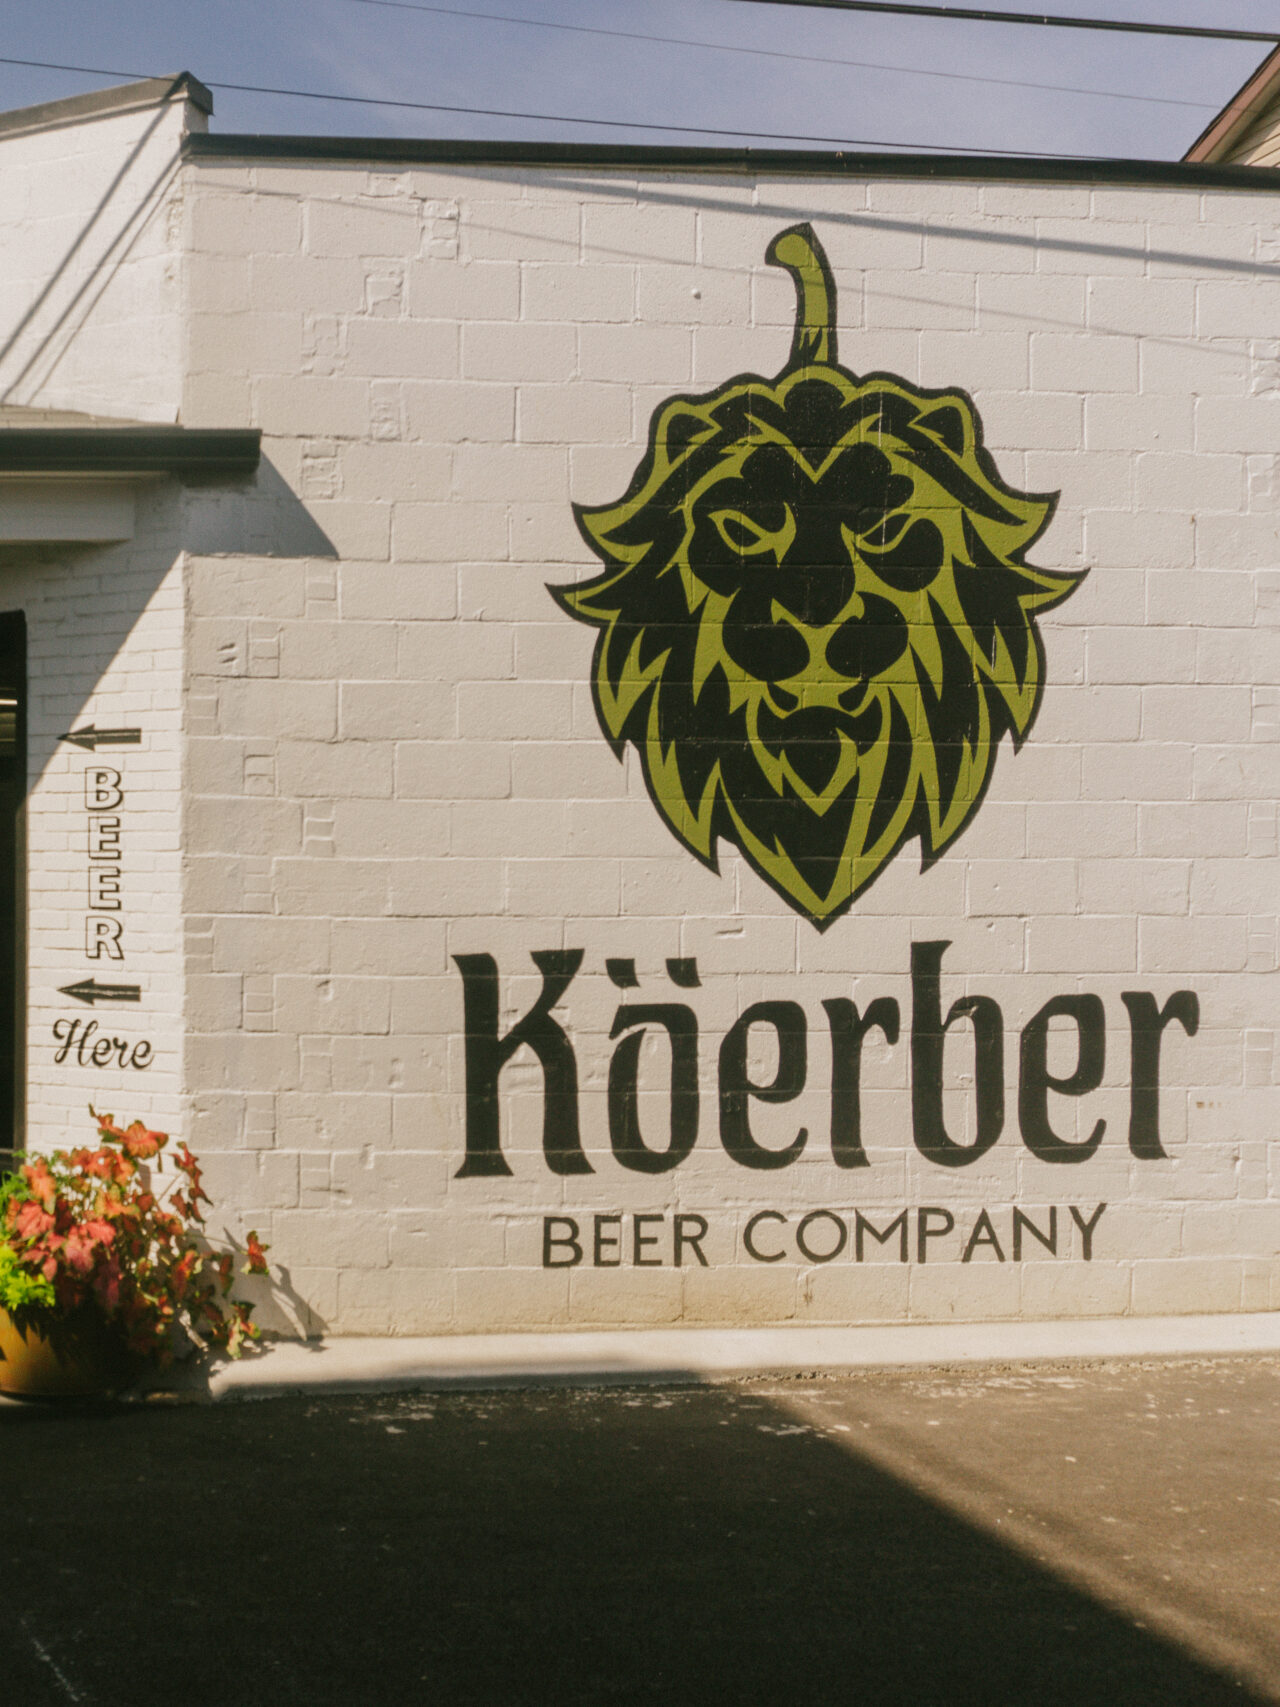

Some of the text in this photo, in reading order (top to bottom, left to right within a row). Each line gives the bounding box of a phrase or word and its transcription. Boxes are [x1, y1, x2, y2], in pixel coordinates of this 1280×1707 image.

[85, 767, 124, 960] BEER
[52, 1018, 154, 1070] Here
[542, 1203, 1108, 1268] BEER COMPANY
